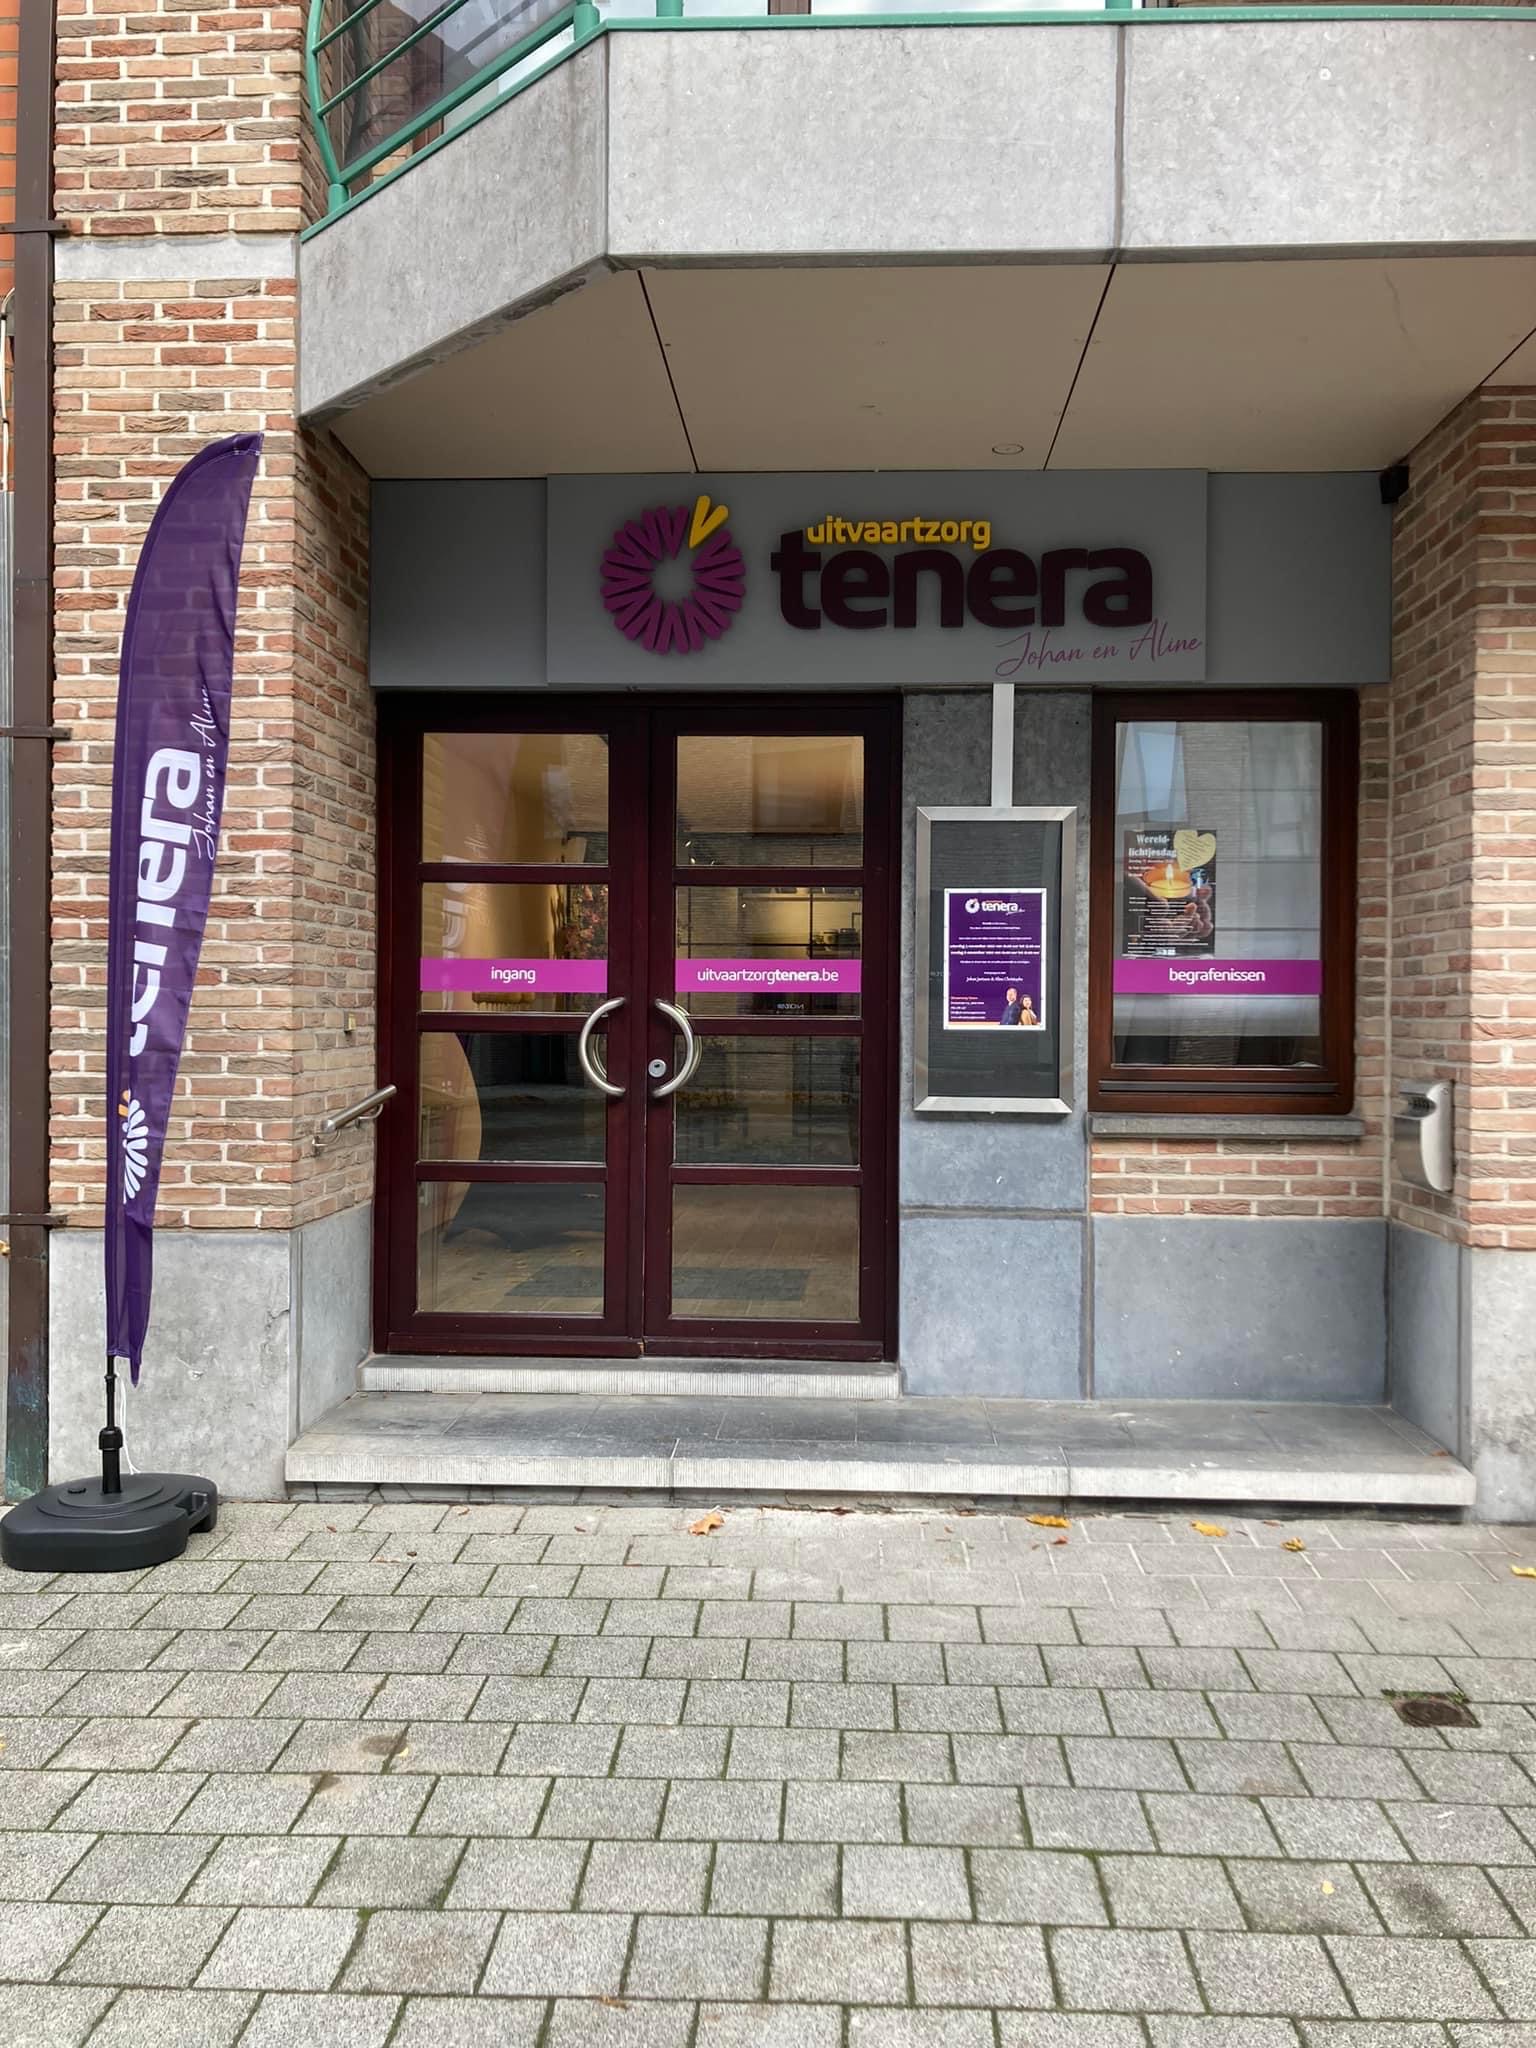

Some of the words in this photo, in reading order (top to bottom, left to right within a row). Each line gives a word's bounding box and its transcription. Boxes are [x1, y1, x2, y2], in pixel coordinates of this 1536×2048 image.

[806, 514, 991, 550] uitvaartzorg
[771, 529, 1153, 629] tenera
[995, 633, 1085, 677] Johan
[1092, 644, 1120, 660] en
[1130, 619, 1204, 662] Aline
[192, 784, 216, 860] Johan
[204, 754, 216, 779] en
[1136, 834, 1170, 845] Wereld-
[129, 747, 201, 1057] enera
[981, 901, 1018, 912] tenera
[490, 966, 536, 984] ingang
[697, 968, 839, 985] uitvaartzorgtenera.be
[1168, 967, 1266, 985] begrafenissen
